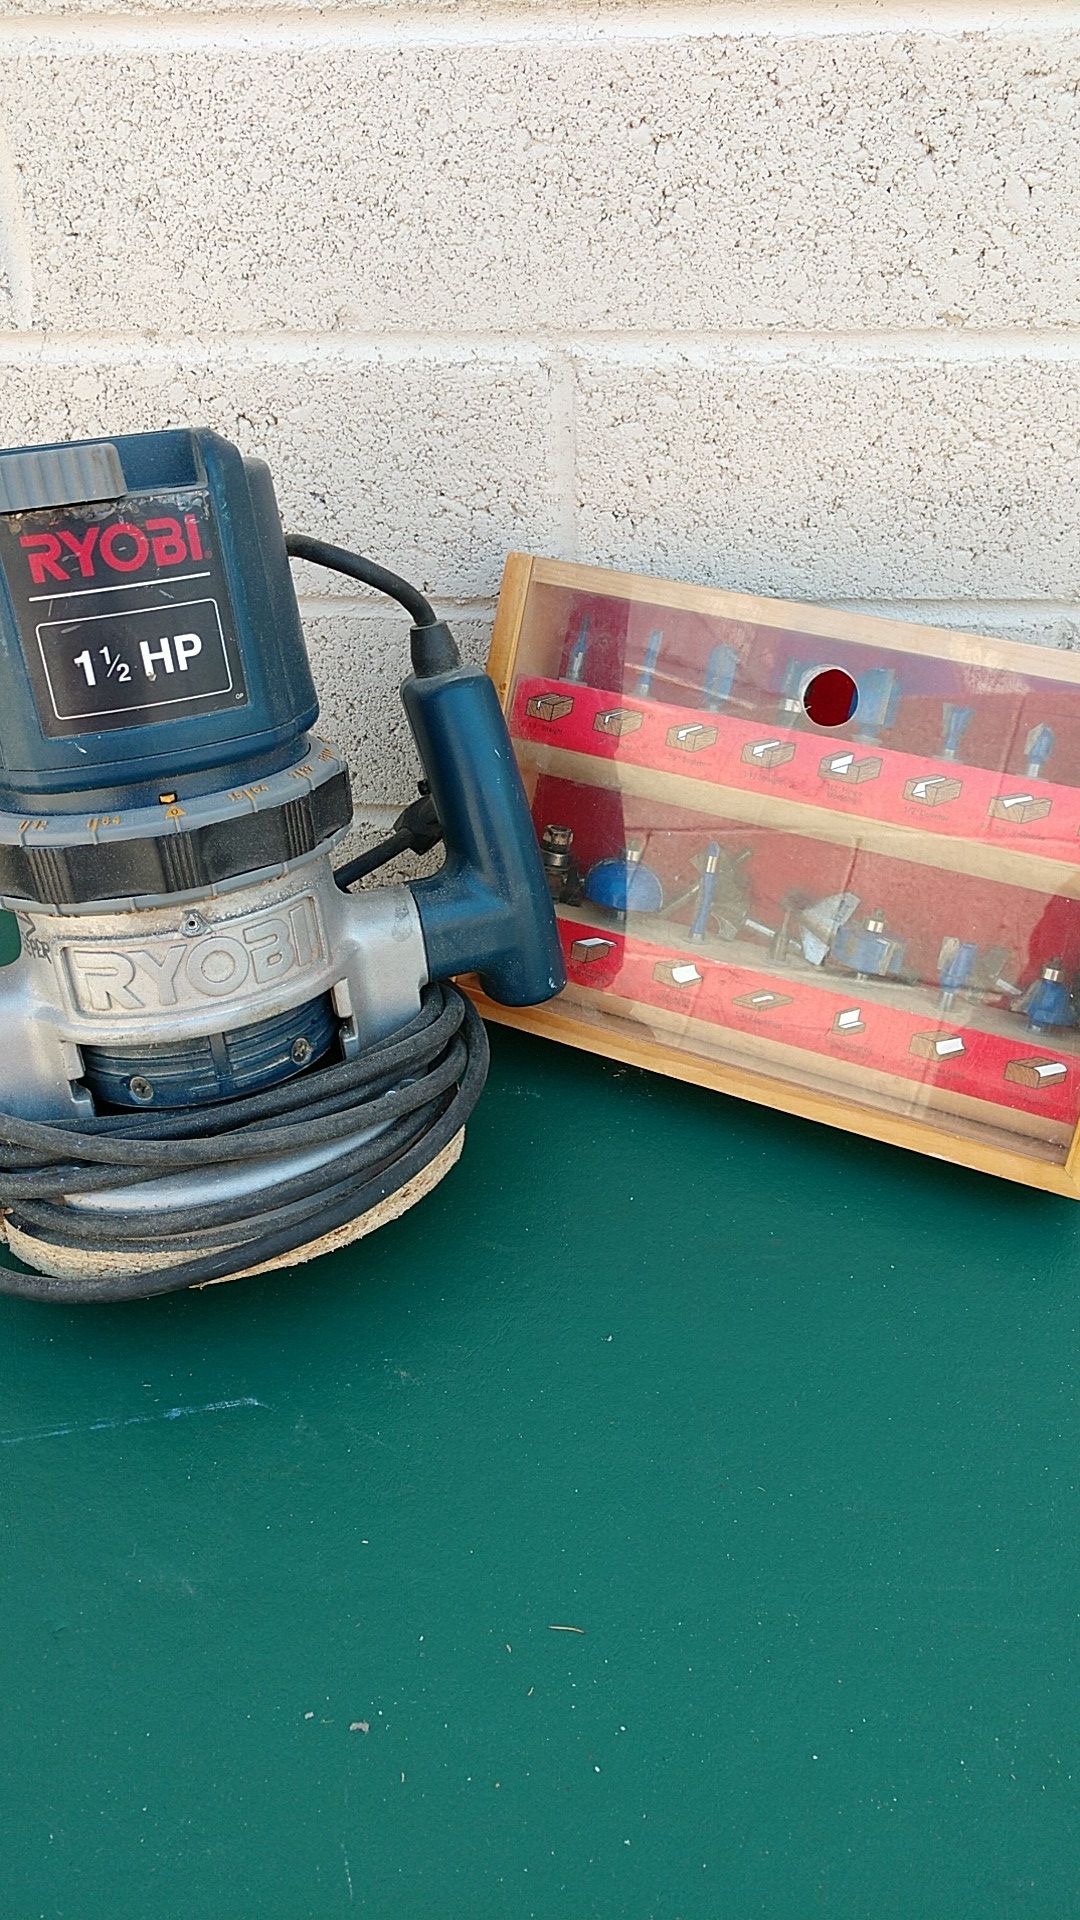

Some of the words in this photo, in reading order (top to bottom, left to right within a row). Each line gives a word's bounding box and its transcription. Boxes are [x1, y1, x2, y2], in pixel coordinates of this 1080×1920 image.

[19, 514, 204, 584] RYOBI
[139, 633, 202, 680] HP
[73, 904, 313, 1012] RYOBI
